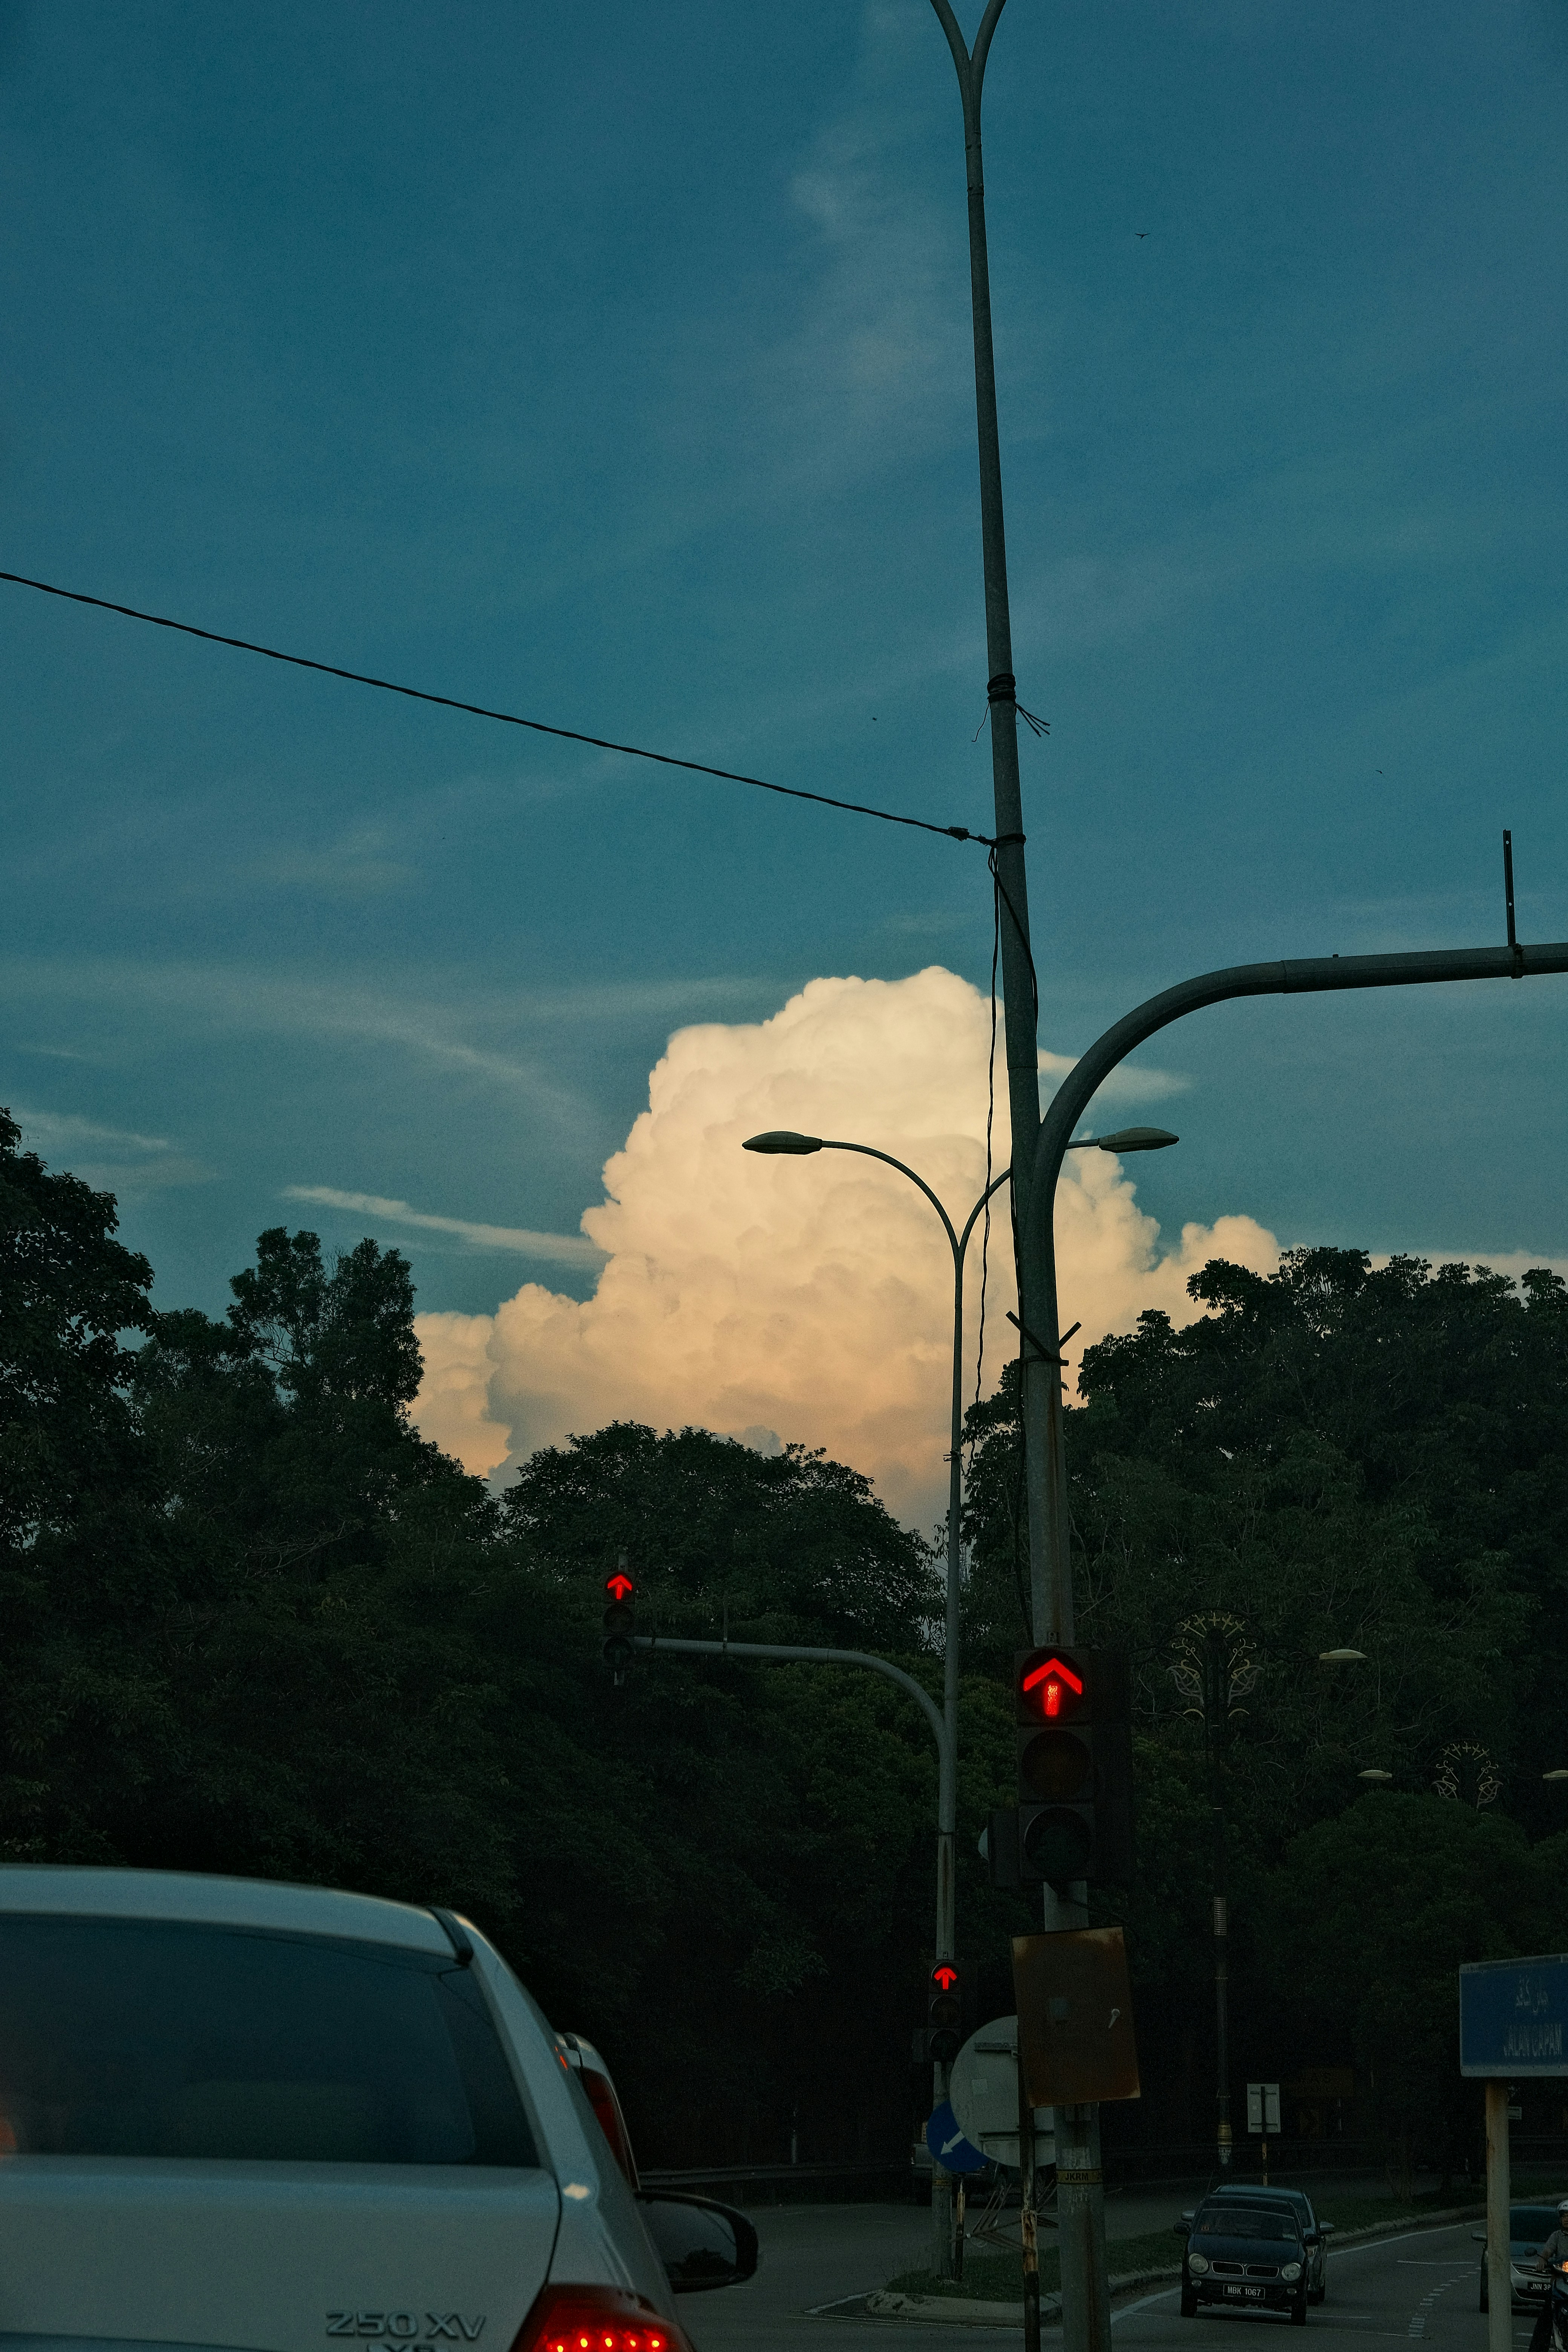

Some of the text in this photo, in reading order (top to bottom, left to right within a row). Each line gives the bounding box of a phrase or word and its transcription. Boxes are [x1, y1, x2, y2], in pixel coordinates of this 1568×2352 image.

[1227, 2286, 1261, 2297] MBK 1067
[425, 2312, 486, 2341] XV
